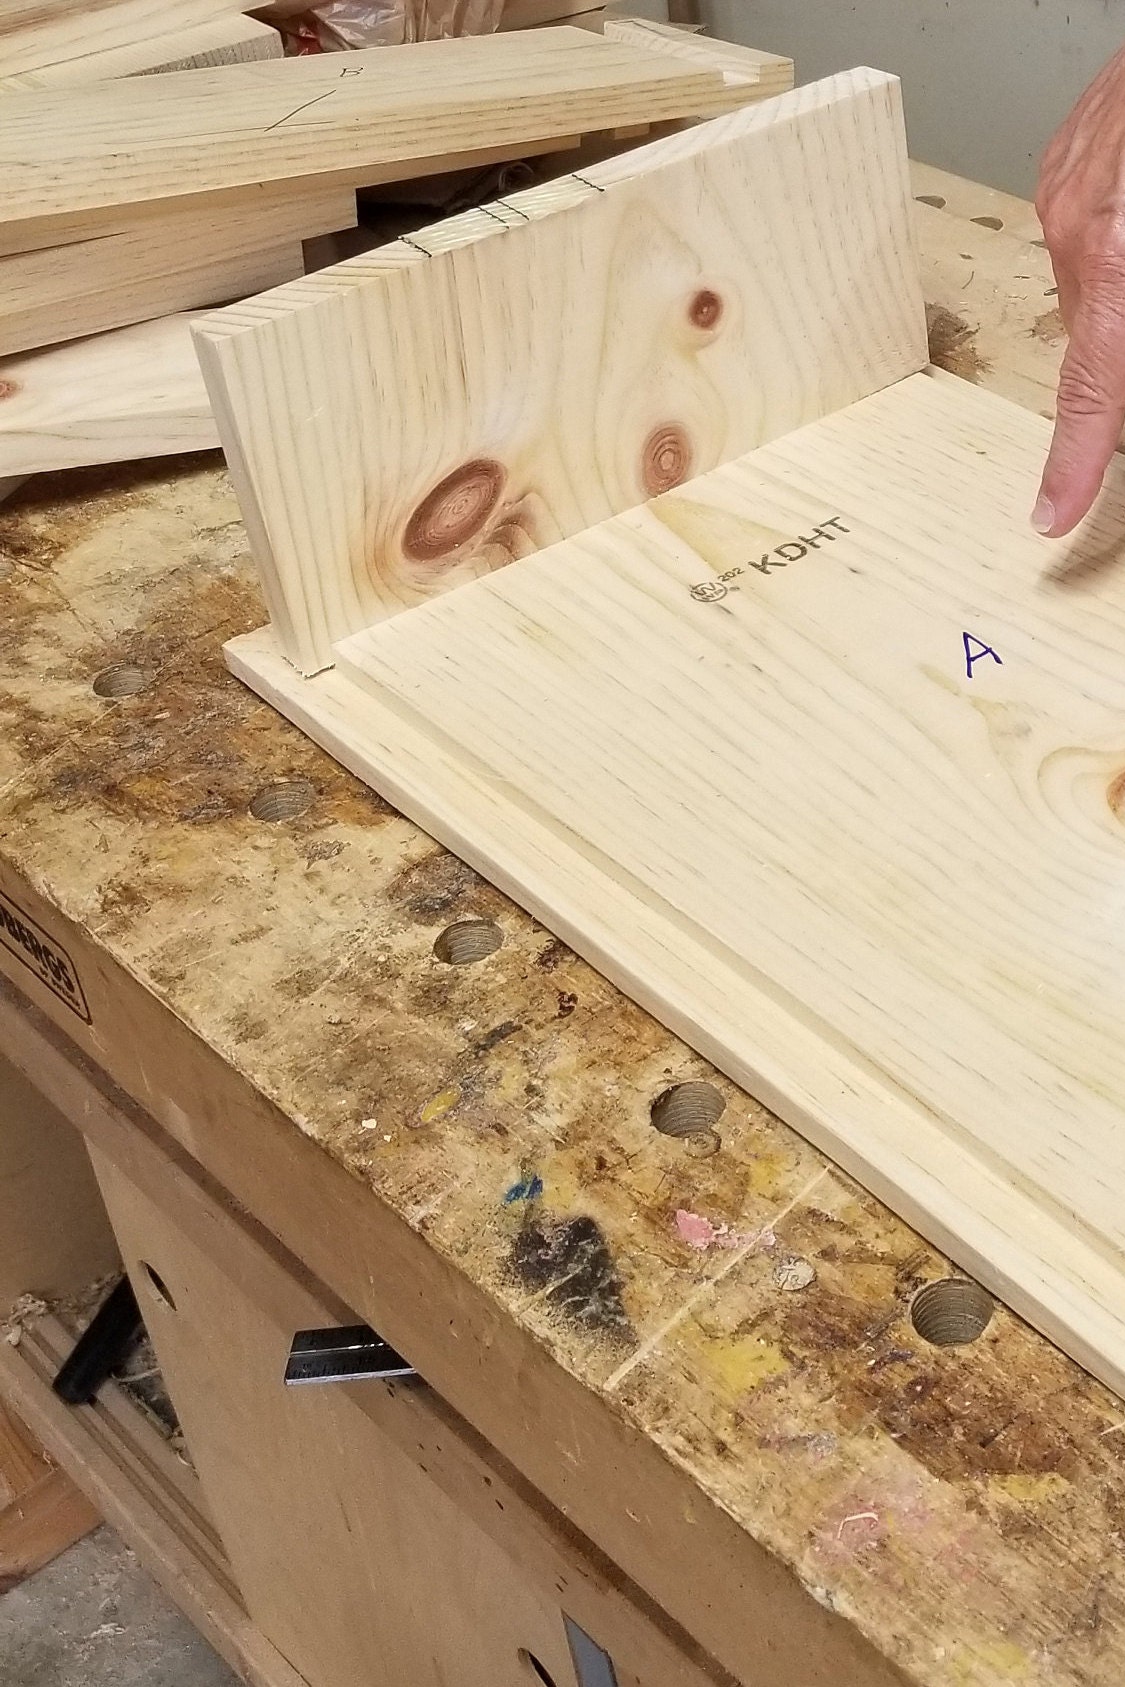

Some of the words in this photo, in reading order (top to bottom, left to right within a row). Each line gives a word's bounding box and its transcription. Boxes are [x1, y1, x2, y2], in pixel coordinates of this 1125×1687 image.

[718, 567, 745, 582] 202
[748, 516, 851, 575] KDHT
[962, 631, 1004, 679] A
[0, 904, 75, 994] BERGS
